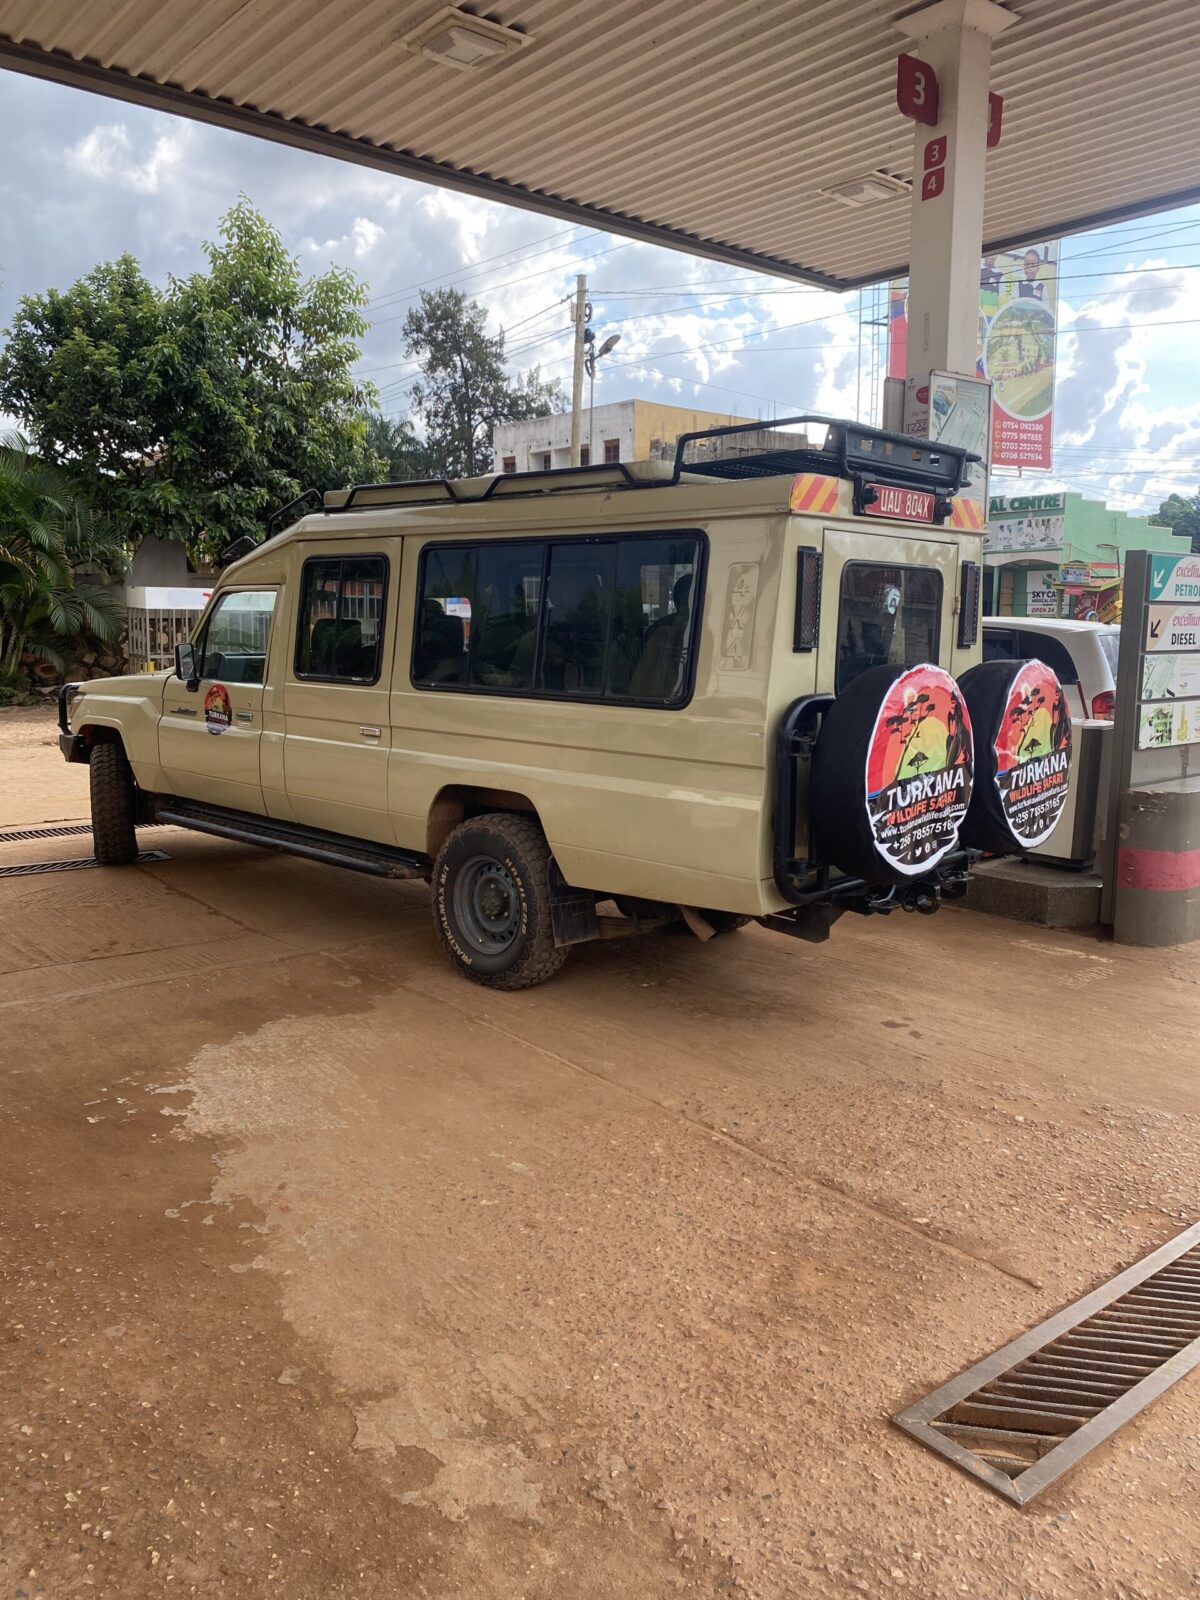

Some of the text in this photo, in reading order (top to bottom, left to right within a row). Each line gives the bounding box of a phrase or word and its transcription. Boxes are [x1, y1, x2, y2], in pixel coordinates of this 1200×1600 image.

[912, 71, 926, 105] 3
[930, 144, 940, 162] 3
[927, 175, 937, 191] 4
[1001, 431, 1018, 440] 0775
[1002, 421, 1019, 430] 0754
[1001, 442, 1018, 450] 0703
[880, 489, 930, 518] UAU 804X
[1010, 494, 1060, 511] CENTRE
[1171, 633, 1196, 645] DIESEL
[1011, 751, 1068, 790] TURKANA
[887, 767, 965, 810] TURKANA
[1009, 772, 1064, 803] WILDLIFE SAFARI
[885, 790, 957, 826] WILDLIFE SAFARI
[912, 820, 955, 842] 78557516
[438, 886, 473, 965] PRACTICALMAX
